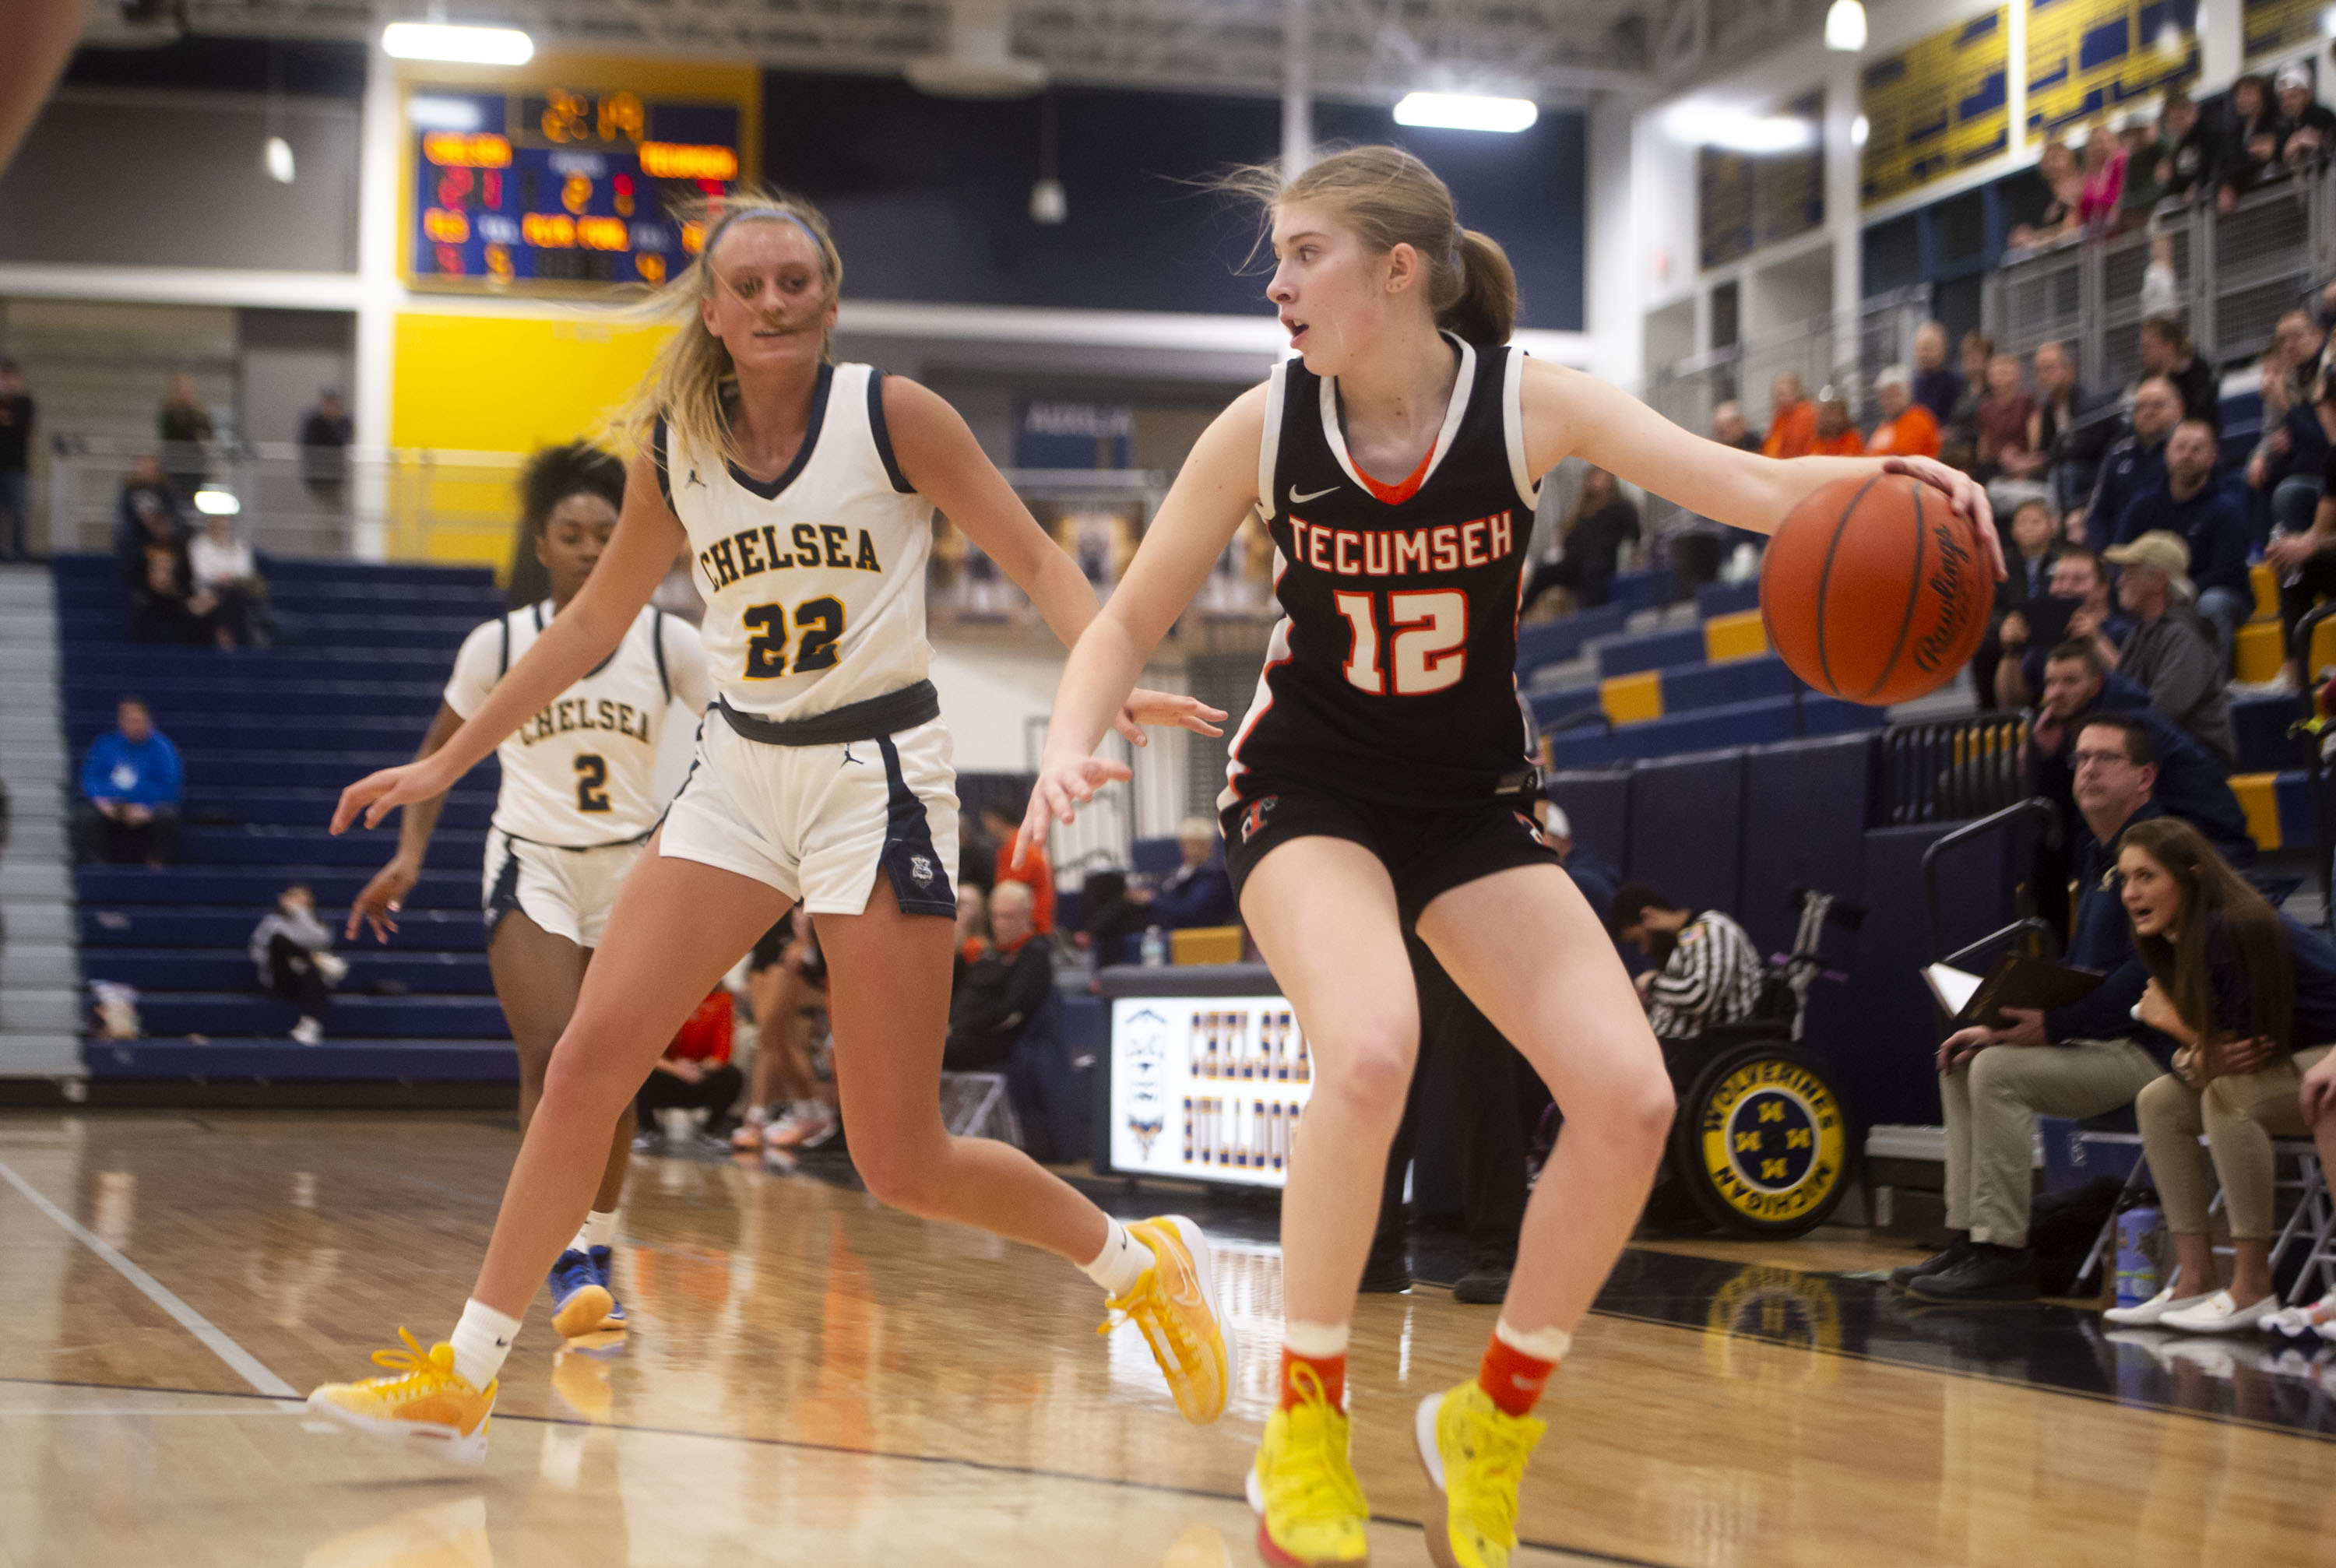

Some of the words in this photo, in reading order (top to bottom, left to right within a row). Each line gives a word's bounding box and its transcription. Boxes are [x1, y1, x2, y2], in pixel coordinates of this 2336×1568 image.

[699, 523, 881, 593] CHELSEA
[1288, 509, 1512, 576] TECUMSEH
[1915, 523, 1970, 672] Rawlings
[742, 594, 846, 681] 22
[1332, 588, 1469, 696] 12
[573, 752, 612, 814] 2
[1703, 1061, 1834, 1131] WOLVERINES
[1713, 1160, 1832, 1215] MICHIGAN
